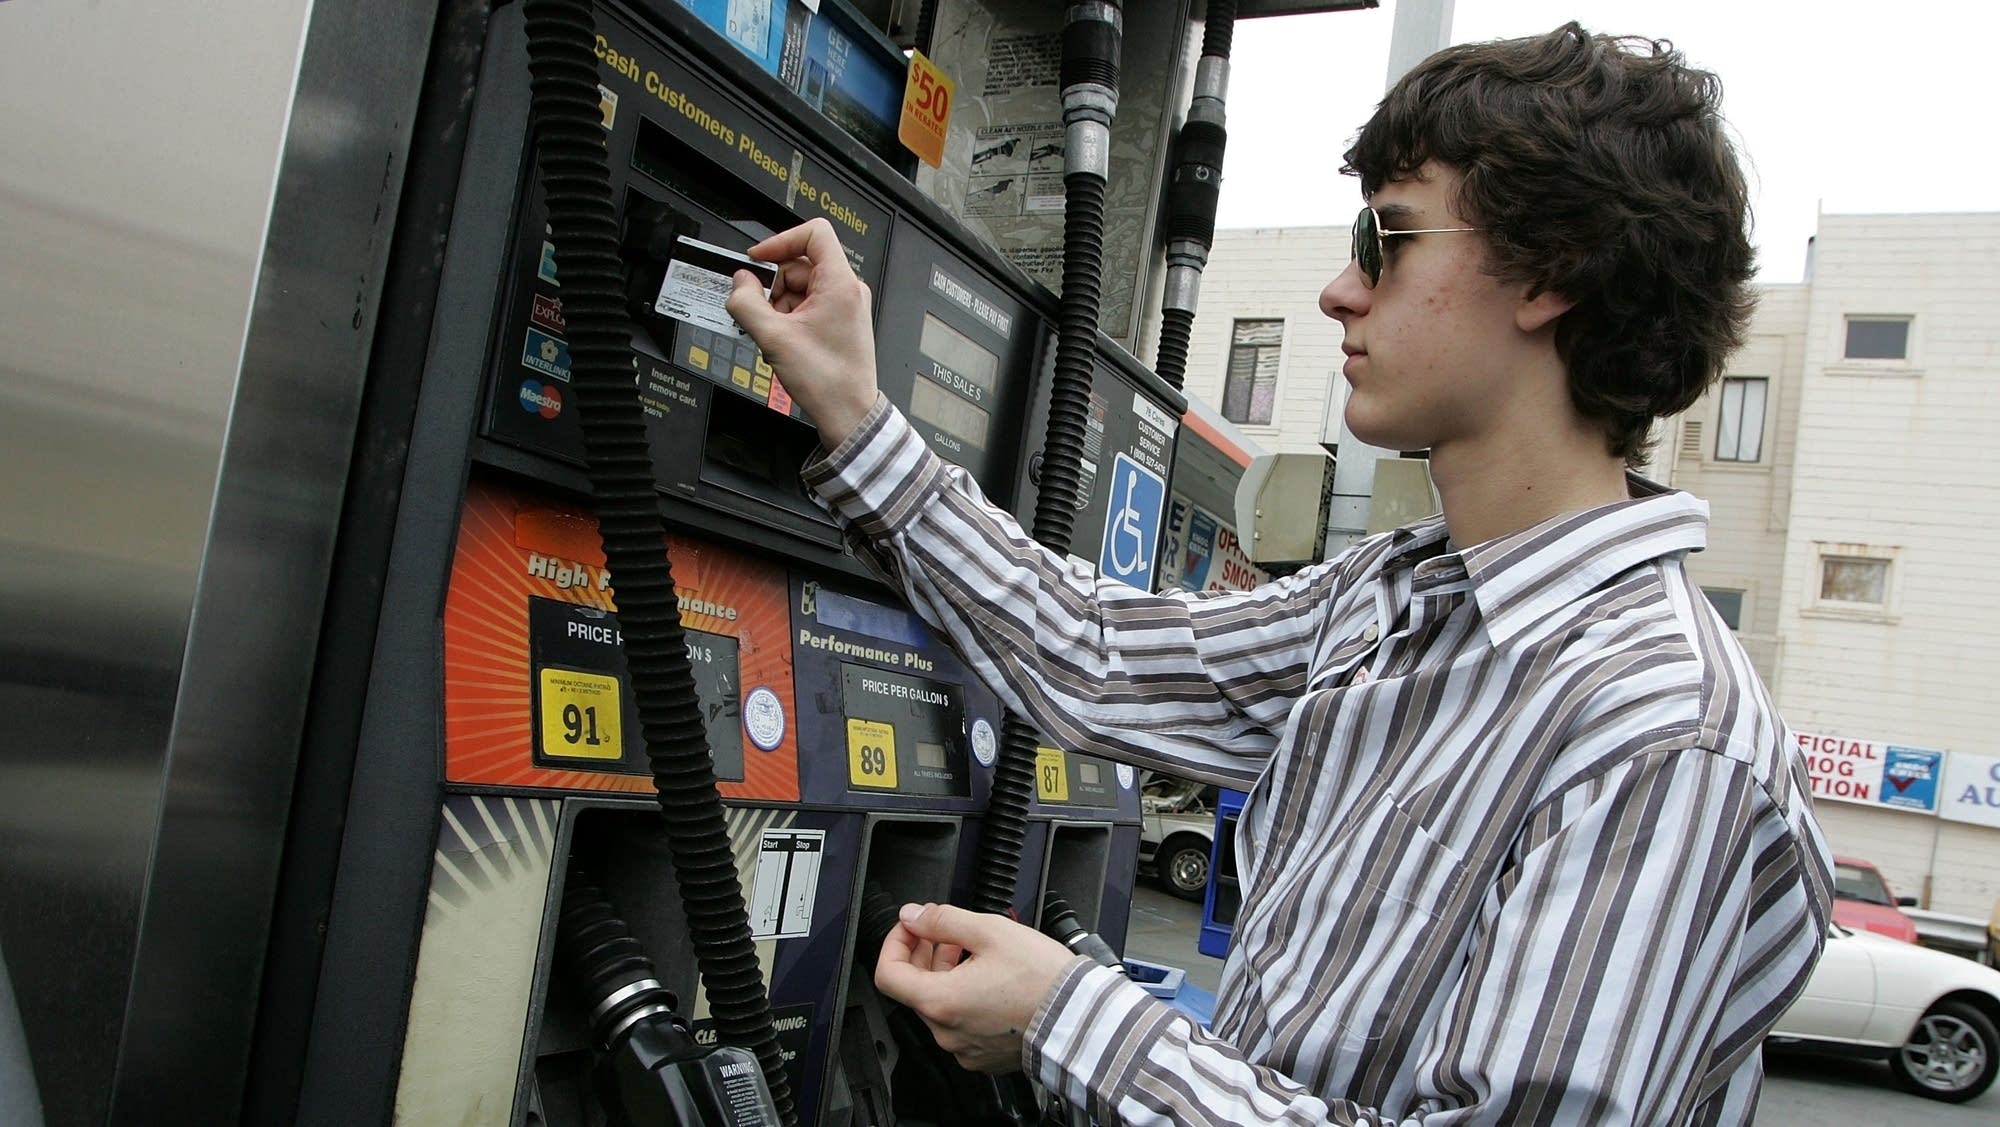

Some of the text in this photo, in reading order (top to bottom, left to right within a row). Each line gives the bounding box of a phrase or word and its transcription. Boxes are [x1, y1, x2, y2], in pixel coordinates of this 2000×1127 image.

[828, 27, 852, 57] GET
[911, 63, 948, 123] $50
[594, 34, 640, 83] Cash
[645, 71, 734, 146] Customers
[739, 133, 788, 182] Please
[820, 191, 868, 236] Cashier
[913, 107, 944, 137] REBATES
[933, 271, 948, 292] CASH
[946, 278, 972, 309] CUSTOMERS
[973, 298, 990, 320] PLEASE
[988, 308, 998, 326] PAY
[996, 314, 1009, 334] FIRST
[525, 353, 570, 379] INTERLINK
[651, 367, 691, 391] Insert and
[932, 362, 952, 384] THIS
[953, 375, 975, 397] SALE
[520, 387, 562, 413] Maestro
[649, 382, 698, 408] remove card.
[934, 432, 961, 452] GALLONS
[1138, 420, 1166, 446] CUSTOMER
[1139, 436, 1161, 458] SERVICE
[527, 552, 589, 590] High
[1222, 559, 1257, 592] SMOG
[567, 621, 613, 645] PRICE
[799, 628, 933, 672] Performance Plus
[862, 678, 889, 695] PRICE
[890, 684, 908, 699] PER
[909, 688, 943, 706] GALLON
[563, 703, 600, 746] 91
[860, 745, 886, 776] 89
[1798, 735, 1877, 760] FICIAL
[1043, 765, 1059, 793] 87
[1806, 756, 1854, 777] MOG
[1808, 776, 1870, 800] TION
[762, 840, 810, 850] Start Stop
[720, 1061, 755, 1078] WARNING
